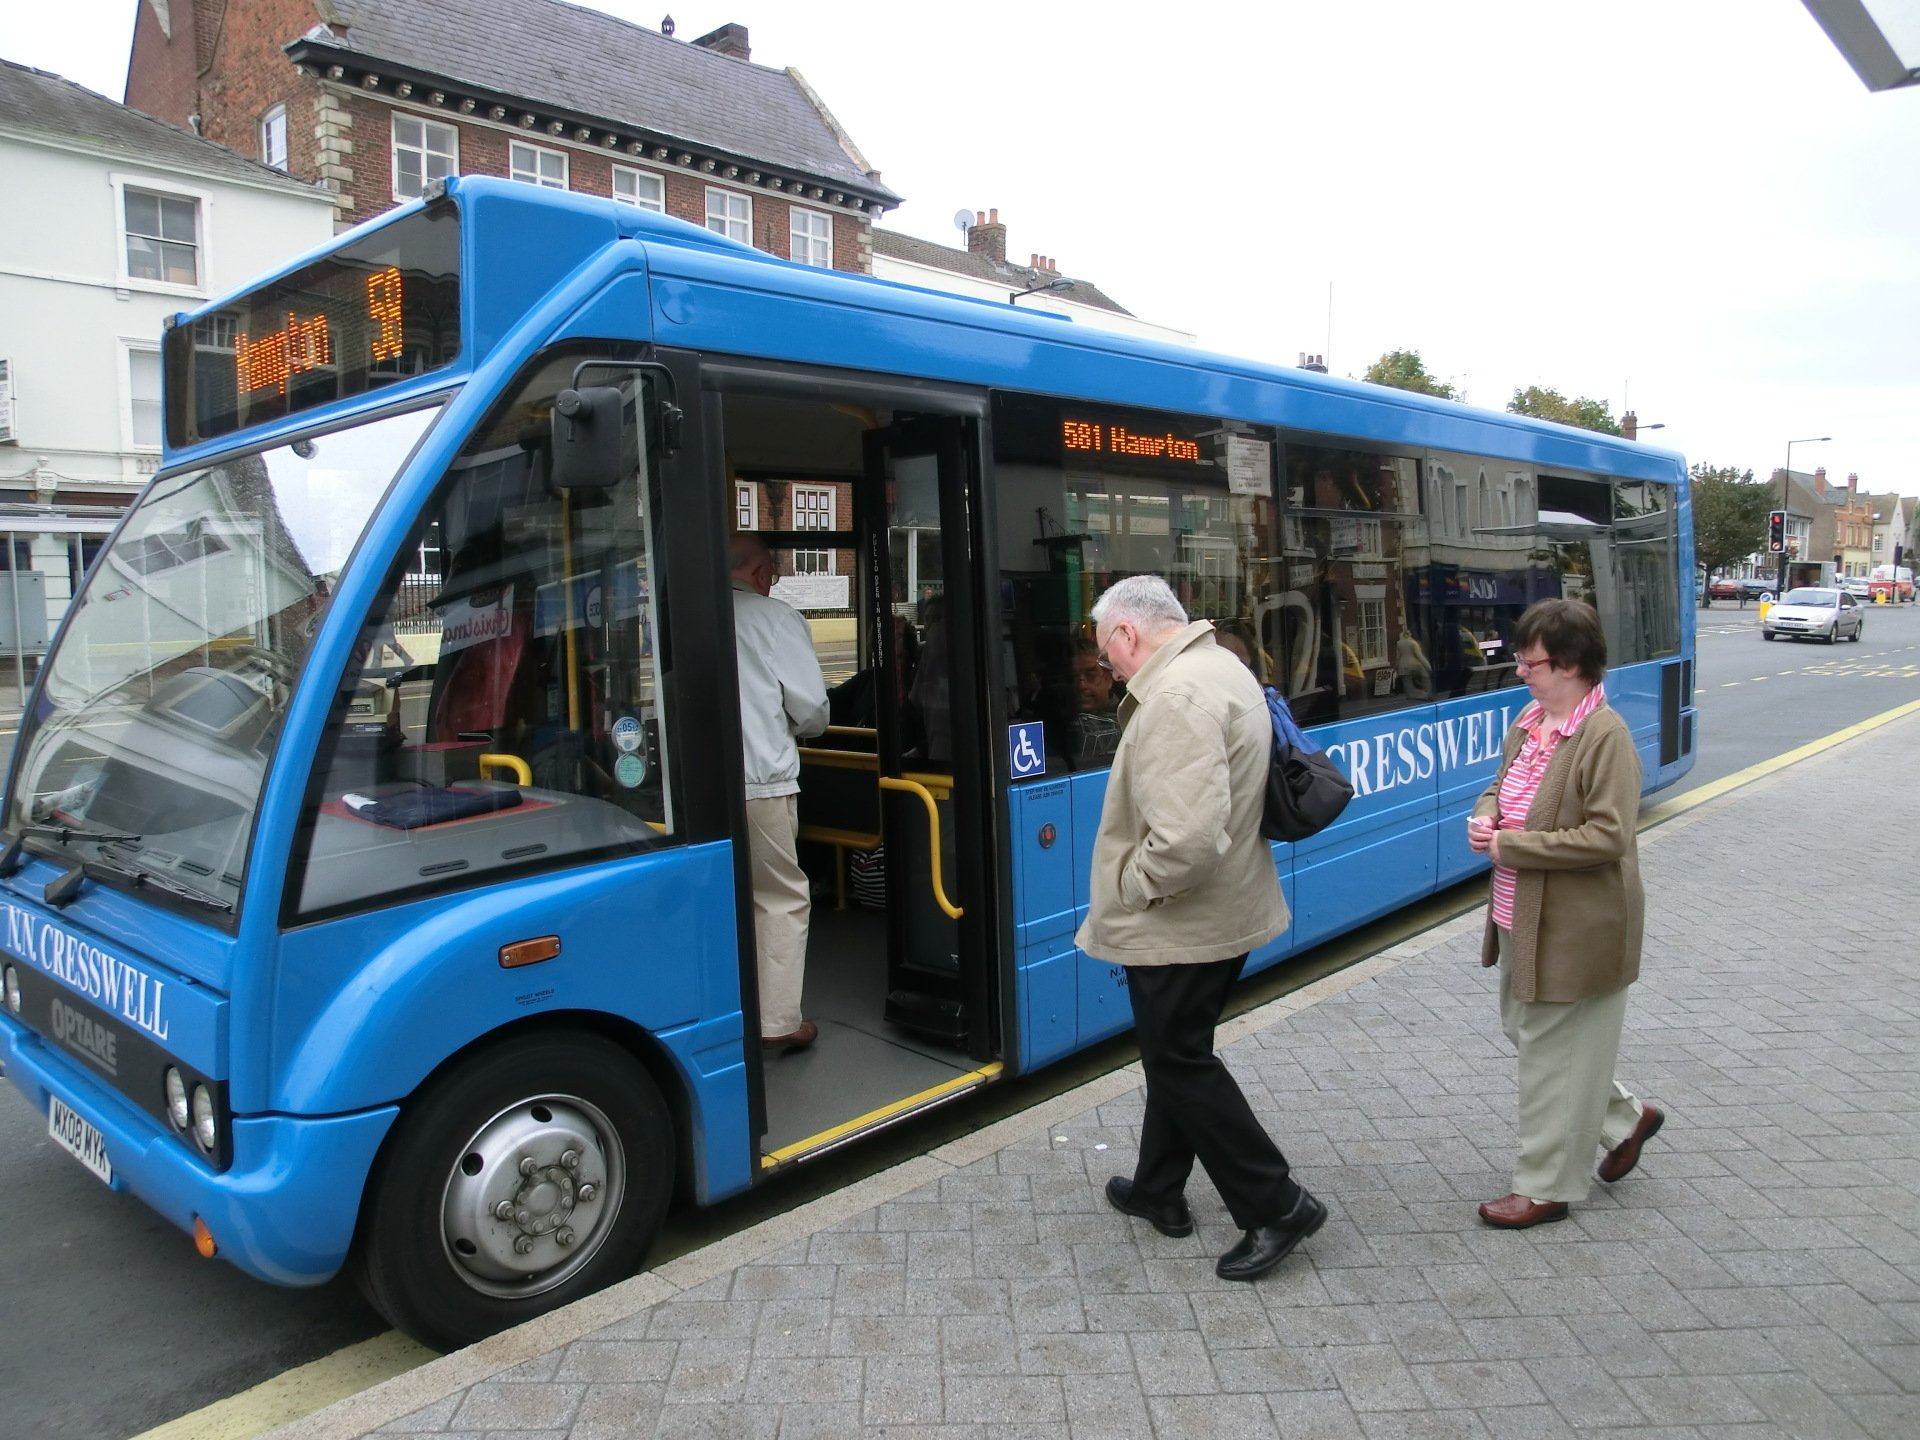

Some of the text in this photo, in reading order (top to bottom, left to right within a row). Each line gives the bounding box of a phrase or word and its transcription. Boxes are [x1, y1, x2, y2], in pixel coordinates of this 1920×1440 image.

[234, 312, 330, 394] Hampton
[1064, 421, 1199, 460] 581 Hampton
[40, 923, 169, 1041] CRESSWELL
[51, 998, 117, 1064] OPTARE
[54, 1100, 83, 1151] MX08
